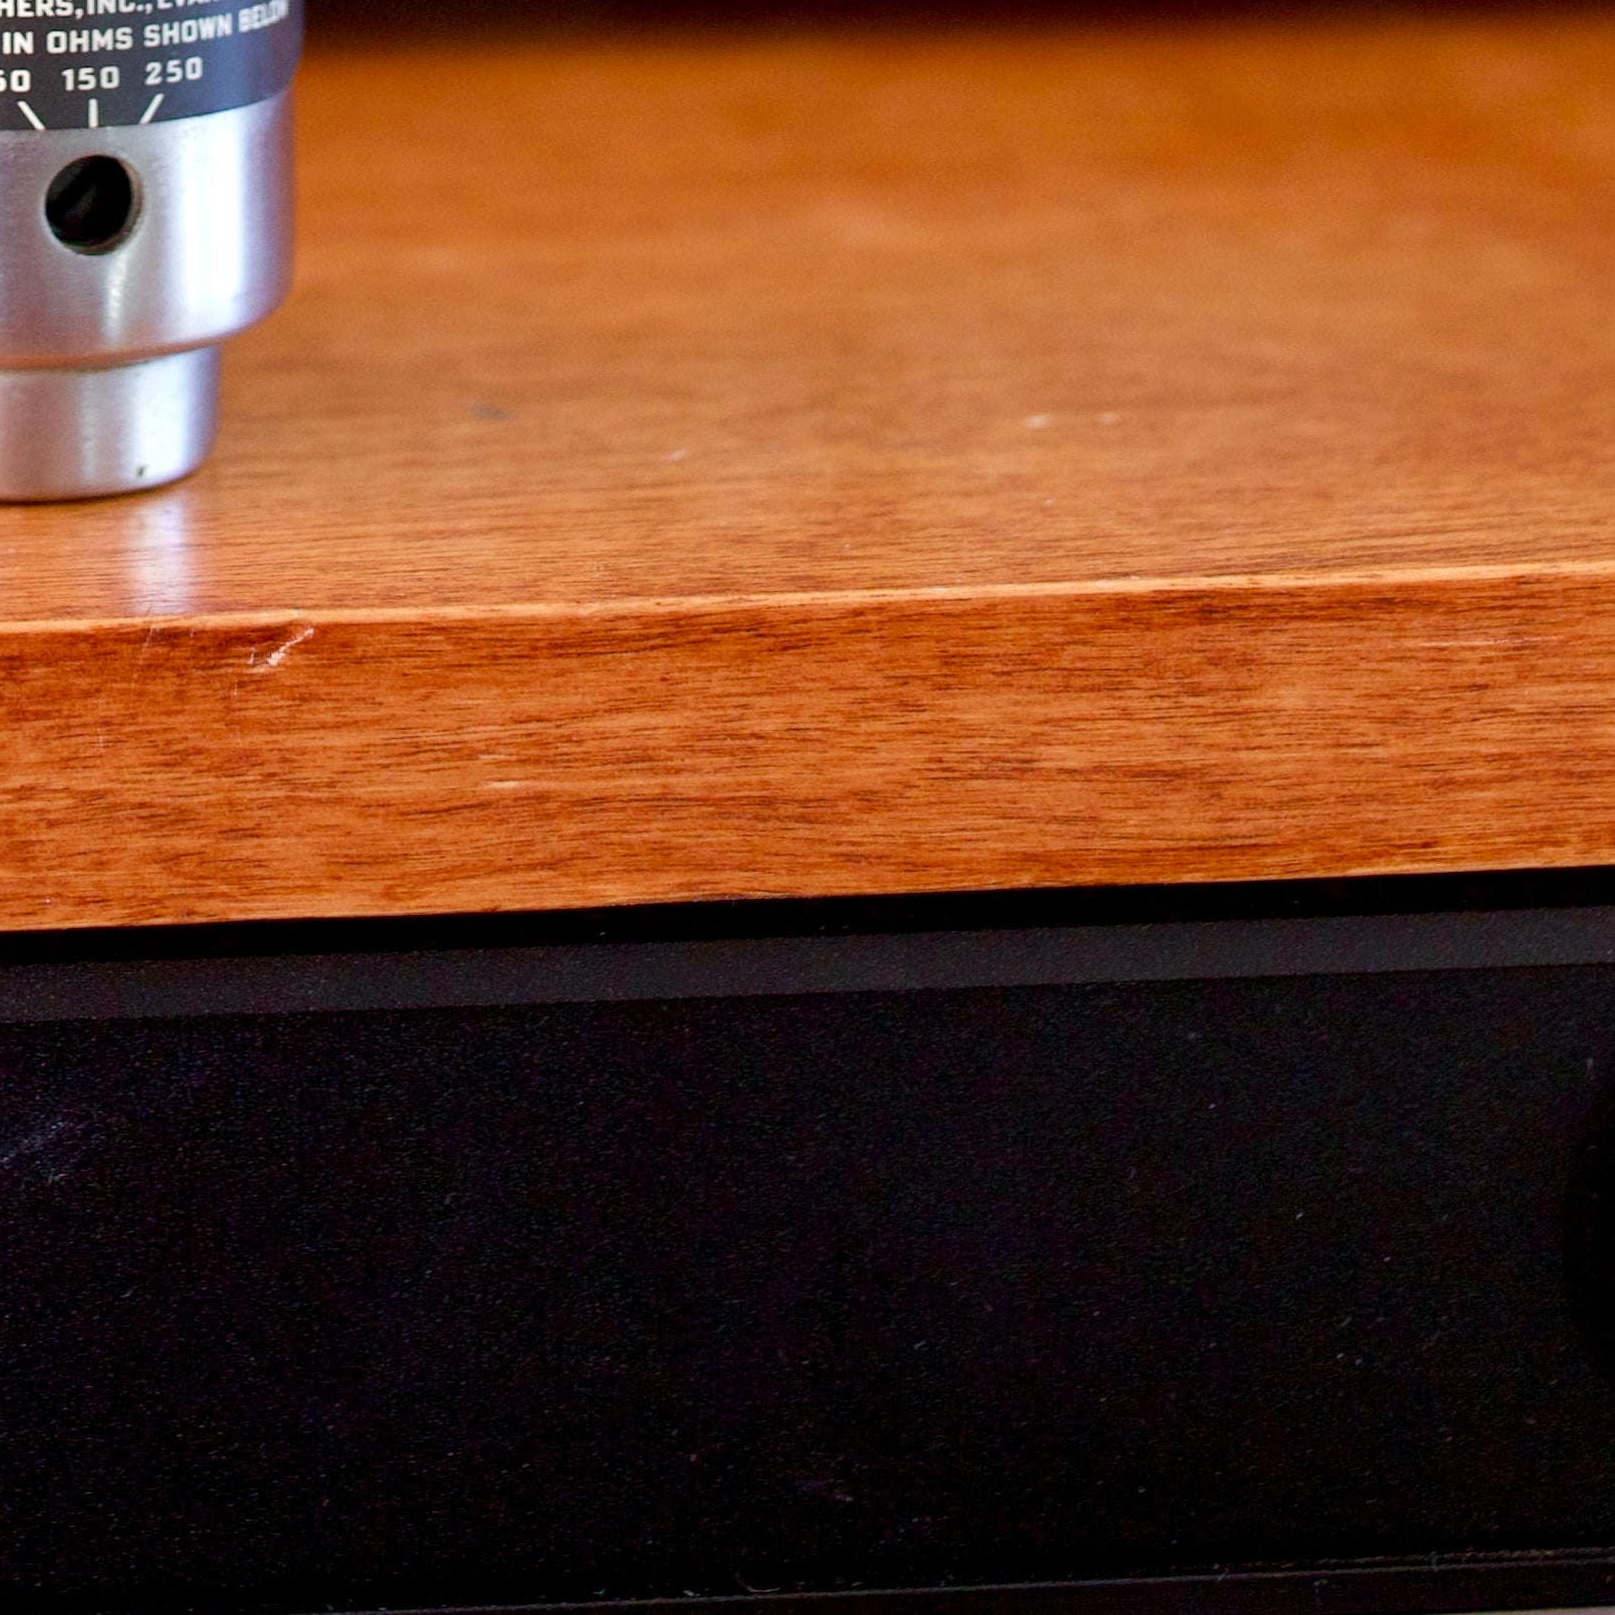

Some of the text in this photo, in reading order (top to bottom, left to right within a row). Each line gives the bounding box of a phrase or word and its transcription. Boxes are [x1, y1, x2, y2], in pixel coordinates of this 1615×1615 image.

[2, 30, 34, 55] IN
[46, 26, 133, 54] OHMS
[143, 12, 234, 48] SHOWN
[61, 65, 120, 92] 150
[144, 55, 204, 87] 250
